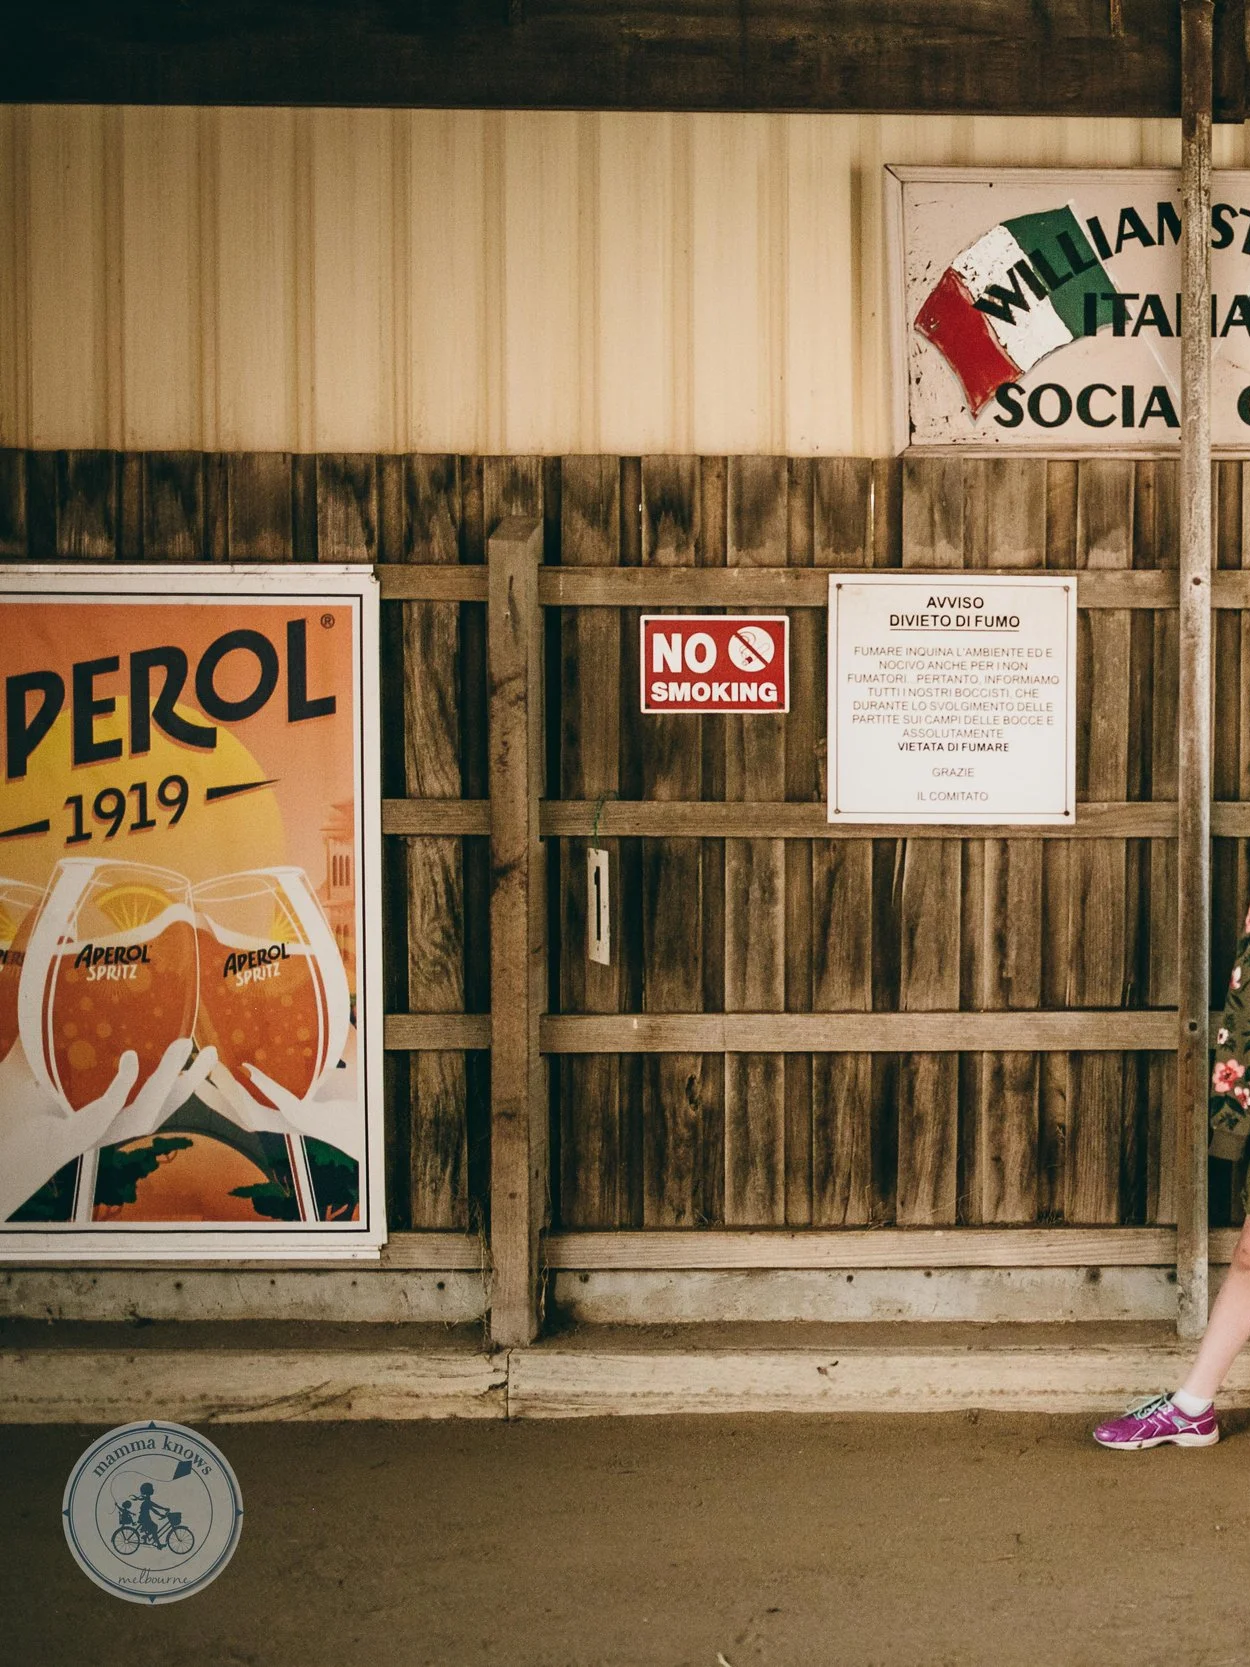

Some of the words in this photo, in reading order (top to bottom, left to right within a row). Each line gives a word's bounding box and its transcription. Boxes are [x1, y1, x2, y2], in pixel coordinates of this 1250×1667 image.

[993, 382, 1182, 428] SOCIA
[926, 596, 985, 609] AVVISO
[889, 614, 951, 627] DIVIETO
[956, 615, 971, 628] DI
[975, 615, 1021, 628] FUMO
[653, 632, 717, 674] NO
[854, 646, 903, 656] FUMARE
[906, 647, 954, 657] INQUINA
[1027, 648, 1043, 658] ED
[879, 660, 925, 670] NOCIVO
[928, 661, 968, 671] ANCHE
[971, 661, 994, 671] PER
[1003, 661, 1028, 671] NON
[984, 675, 1060, 685] INFORMIAMO
[6, 618, 336, 779] PEROL
[651, 681, 778, 703] SMOKING
[868, 688, 900, 697] TUTTI
[908, 688, 952, 697] NOSTRI
[1015, 689, 1039, 698] CHE
[853, 701, 909, 711] DURANTE
[912, 701, 926, 711] LO
[930, 701, 1014, 711] SVOLGIMENTO
[1017, 702, 1053, 712] DELLE
[852, 715, 900, 724] PARTITE
[903, 715, 922, 724] SUI
[924, 715, 961, 724] CAMPI
[964, 716, 1000, 725] DELLE
[1003, 716, 1043, 725] BOCCE
[902, 729, 1004, 738] ASSOLUTAMENTE
[898, 742, 944, 752] VIETATA
[948, 742, 959, 752] DI
[961, 742, 1009, 752] FUMARE
[932, 768, 975, 777] GRAZIE
[917, 792, 926, 801] IL
[929, 792, 989, 801] COMITATO
[65, 775, 189, 844] 1919
[74, 943, 152, 969] APEROL
[223, 943, 290, 978] APEROL
[86, 964, 138, 981] SPRITZ
[236, 962, 281, 987] SPRITZ
